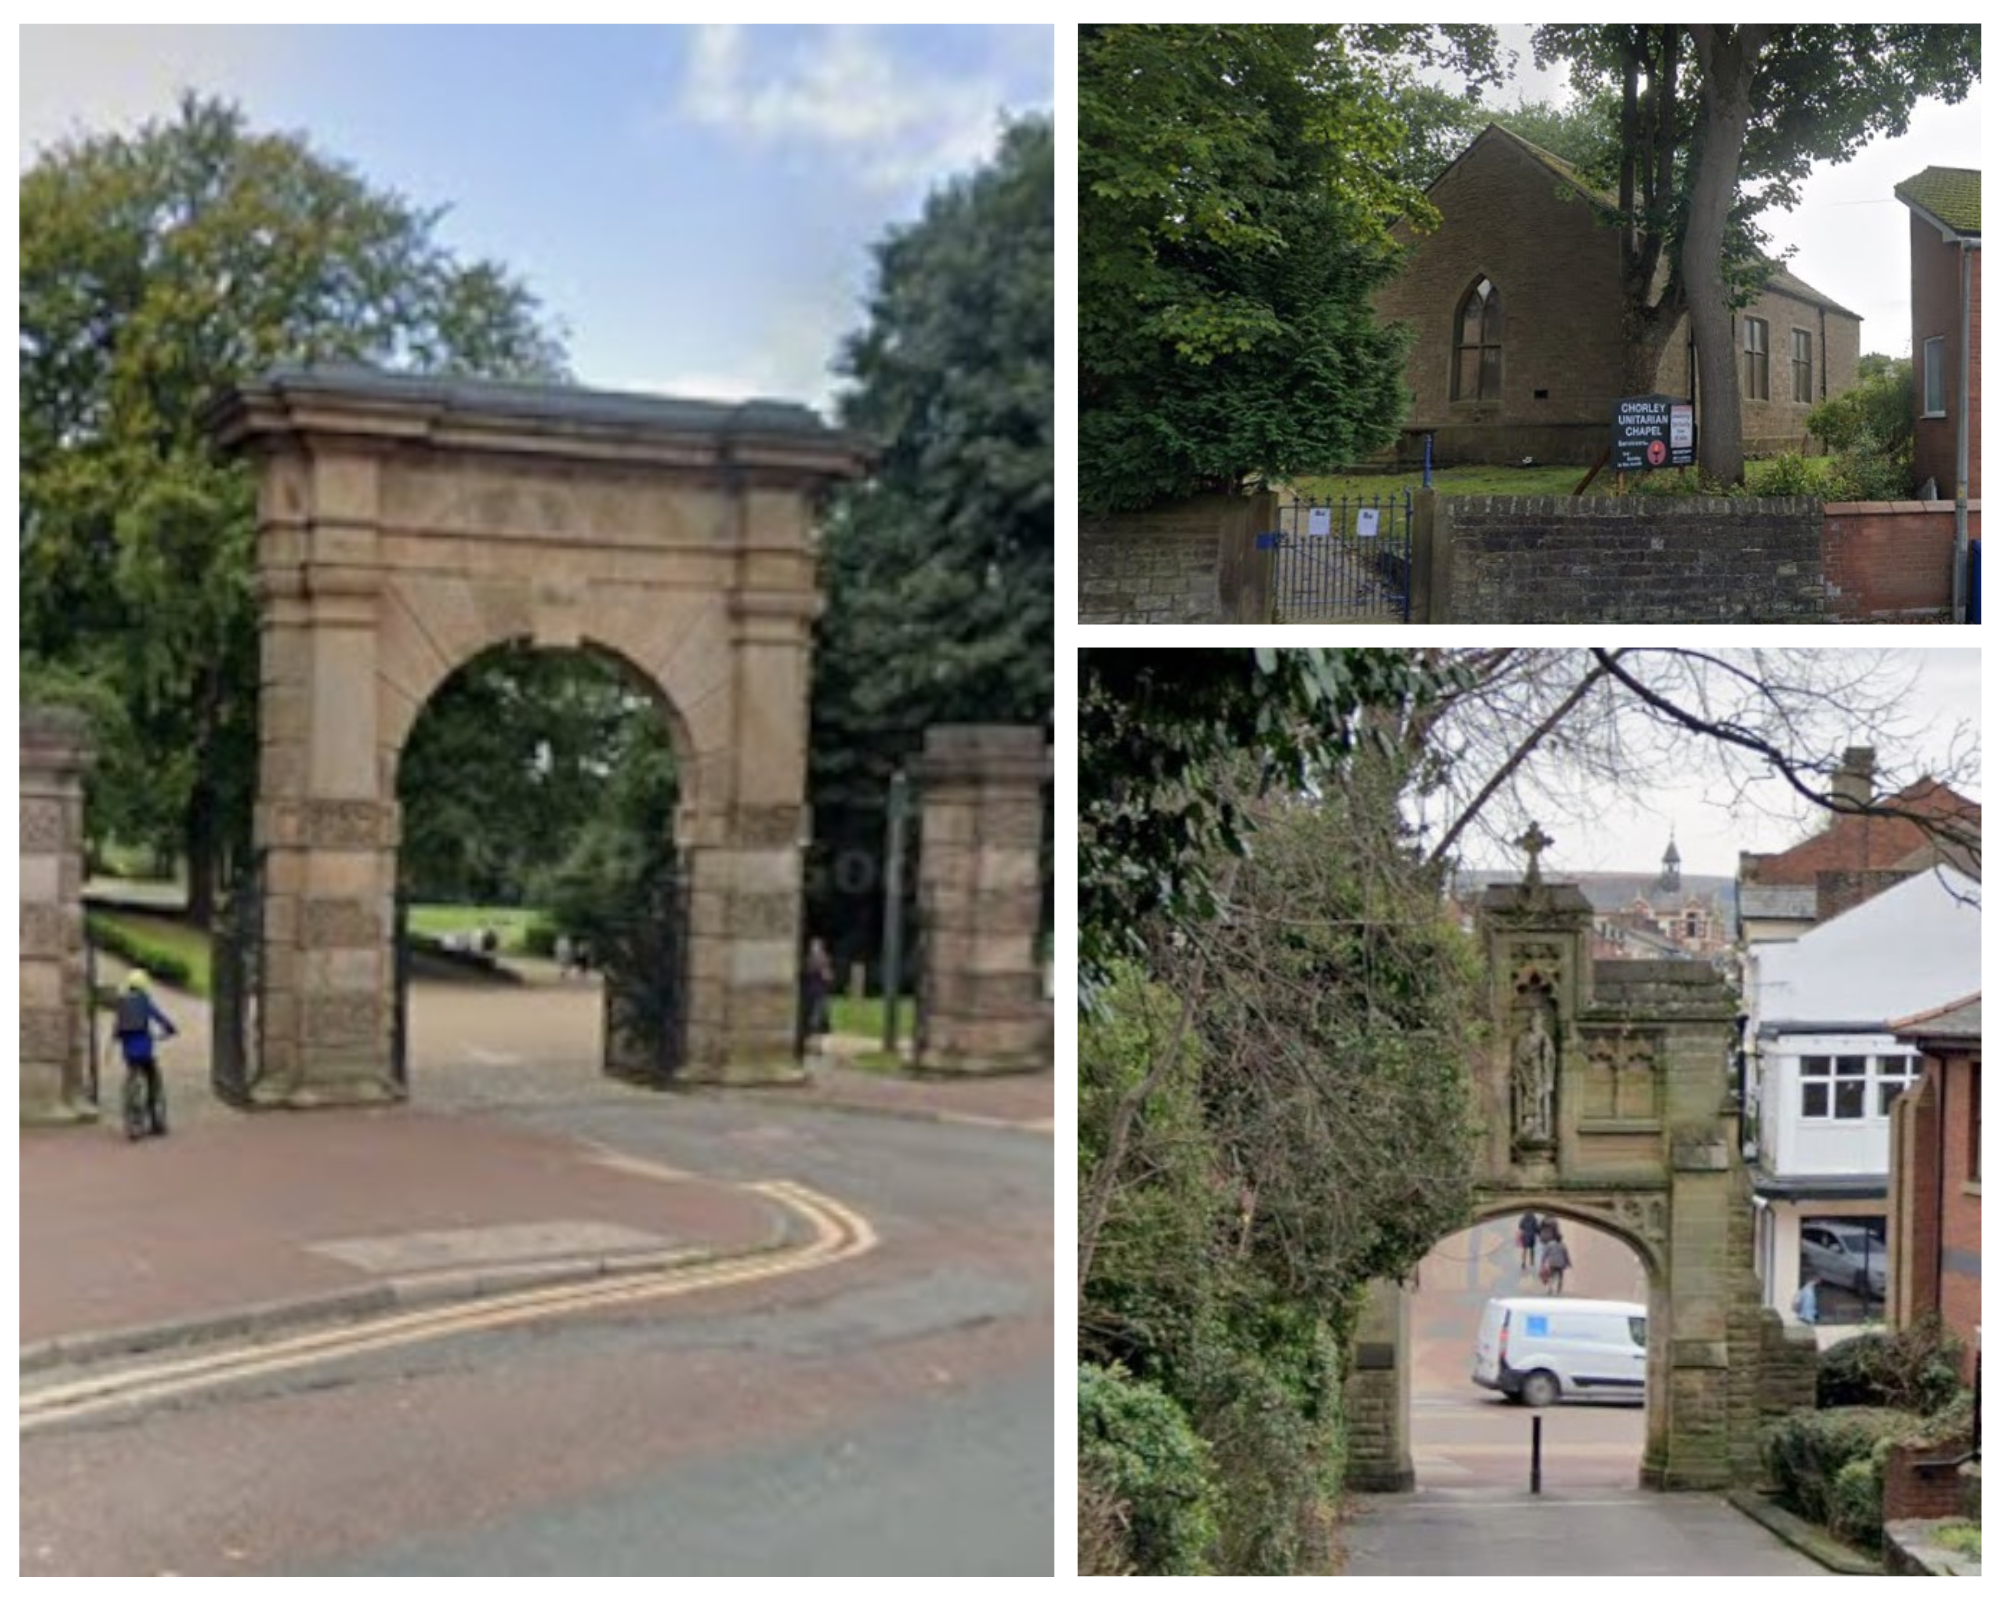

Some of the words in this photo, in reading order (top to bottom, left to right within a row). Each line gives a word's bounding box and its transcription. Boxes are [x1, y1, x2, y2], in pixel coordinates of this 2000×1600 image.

[1621, 403, 1666, 413] CHORLEY
[1618, 414, 1668, 425] UNITARIAN
[1625, 426, 1662, 436] CHAPEL
